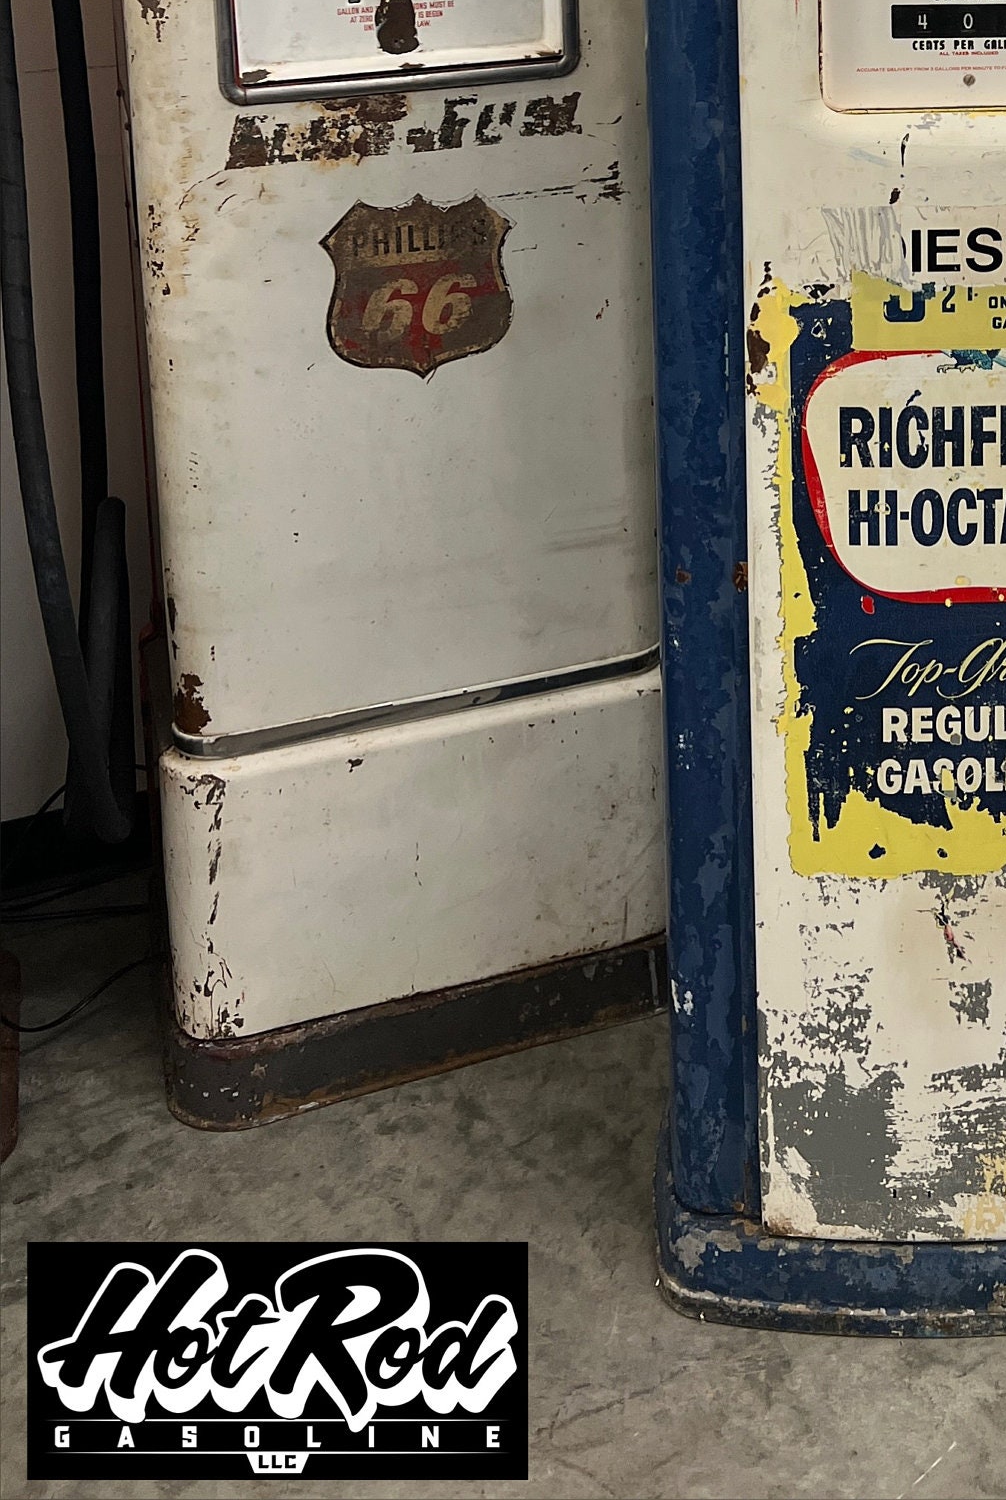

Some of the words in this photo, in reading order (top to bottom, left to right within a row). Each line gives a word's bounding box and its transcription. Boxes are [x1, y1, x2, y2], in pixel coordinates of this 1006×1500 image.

[912, 40, 945, 50] CENTS
[954, 40, 974, 49] PER
[362, 273, 477, 338] 66
